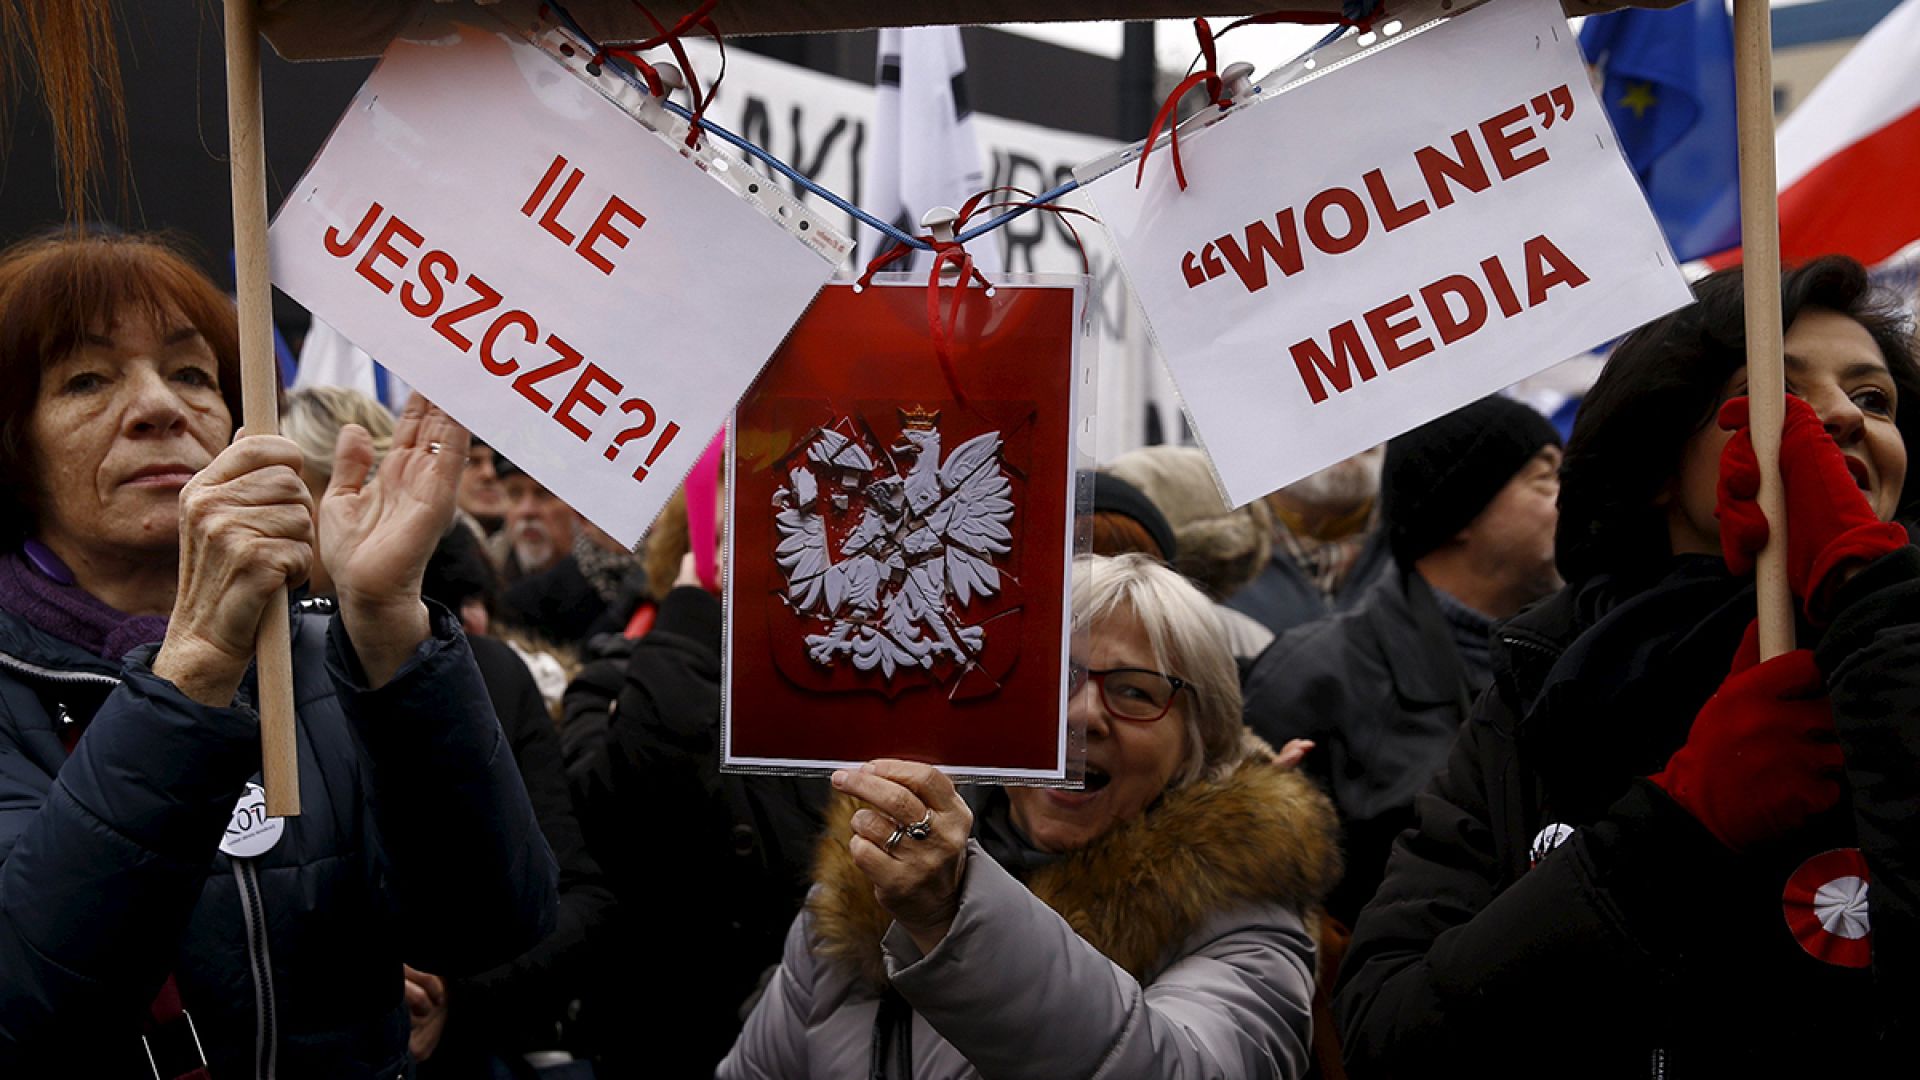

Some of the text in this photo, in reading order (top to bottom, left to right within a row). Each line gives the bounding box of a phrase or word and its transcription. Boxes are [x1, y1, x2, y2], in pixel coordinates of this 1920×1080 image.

[521, 155, 646, 275] ILE
[1182, 85, 1575, 293] “WOLNE”
[324, 203, 681, 483] JESZCZE?!
[1288, 234, 1590, 404] MEDIA
